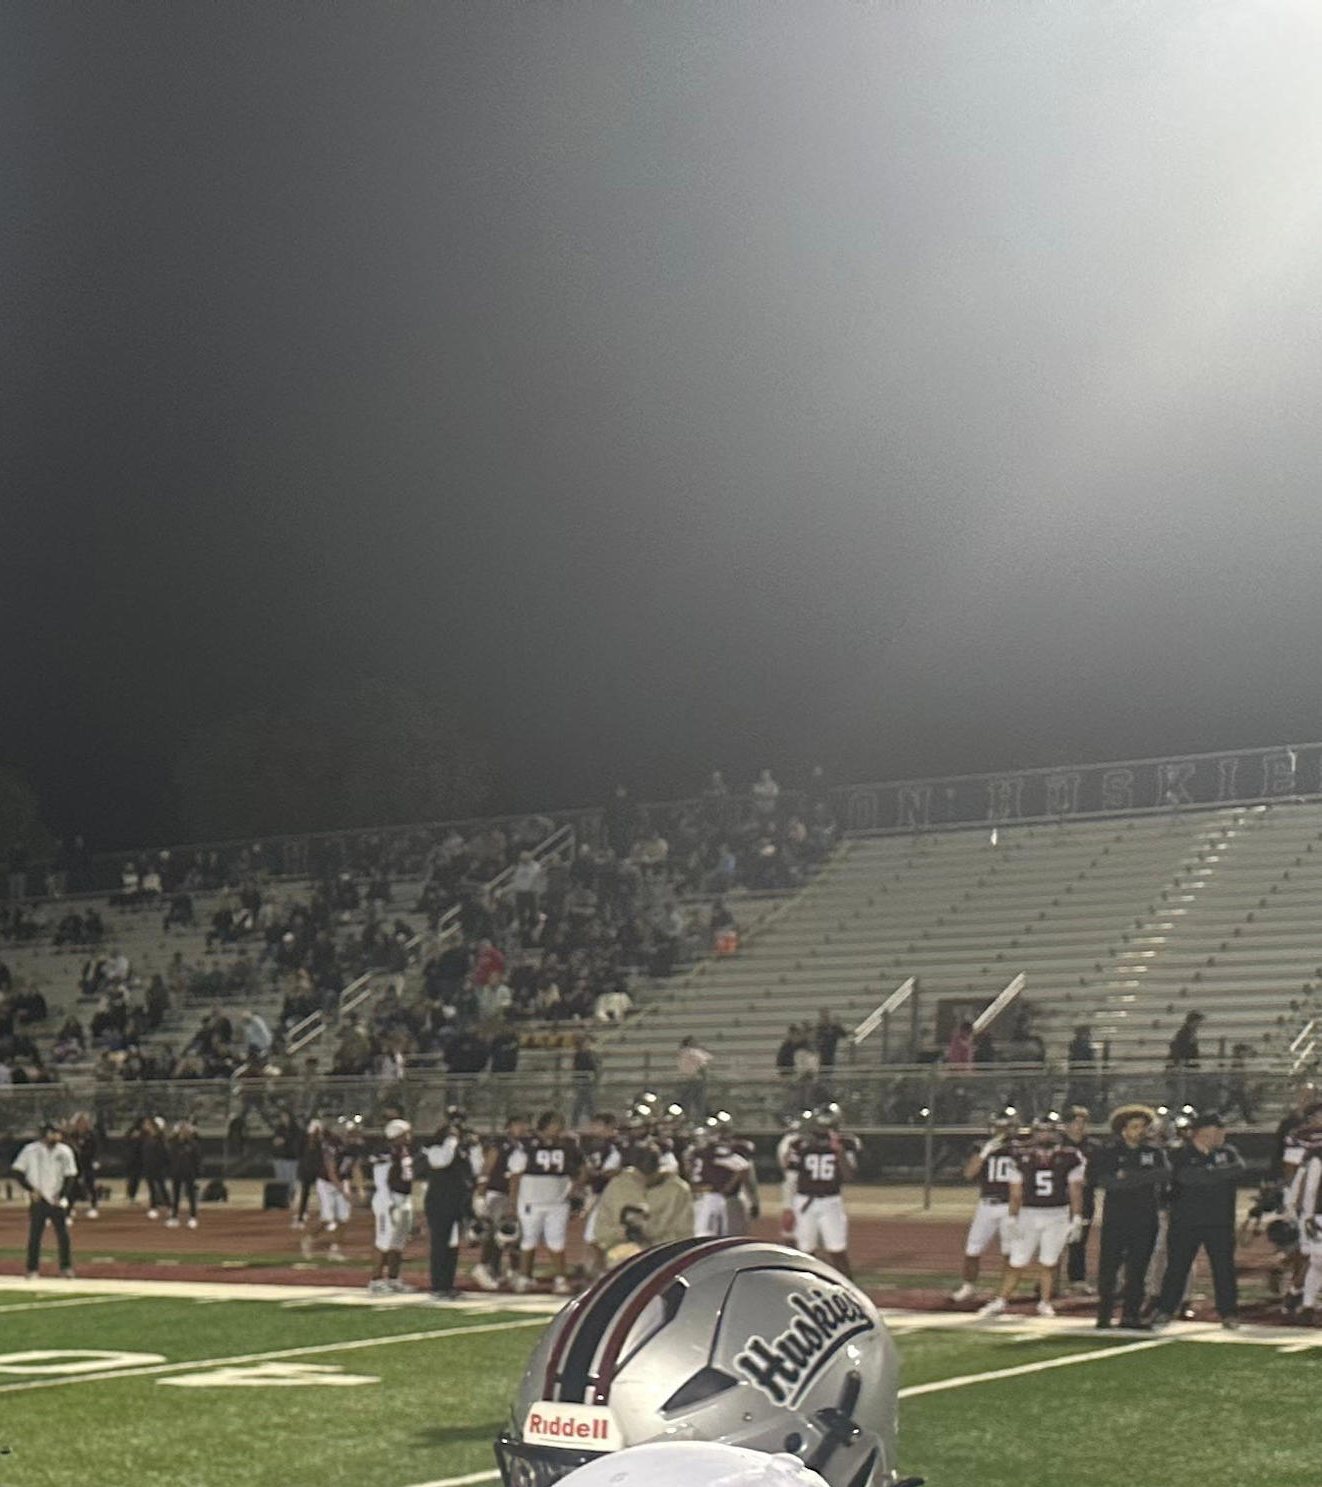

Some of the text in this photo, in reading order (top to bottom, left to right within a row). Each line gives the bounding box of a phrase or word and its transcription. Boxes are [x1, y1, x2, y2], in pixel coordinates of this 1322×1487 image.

[535, 1149, 565, 1173] 99
[804, 1153, 836, 1181] 96
[1034, 1170, 1054, 1197] 5
[529, 1413, 609, 1440] Riddell
